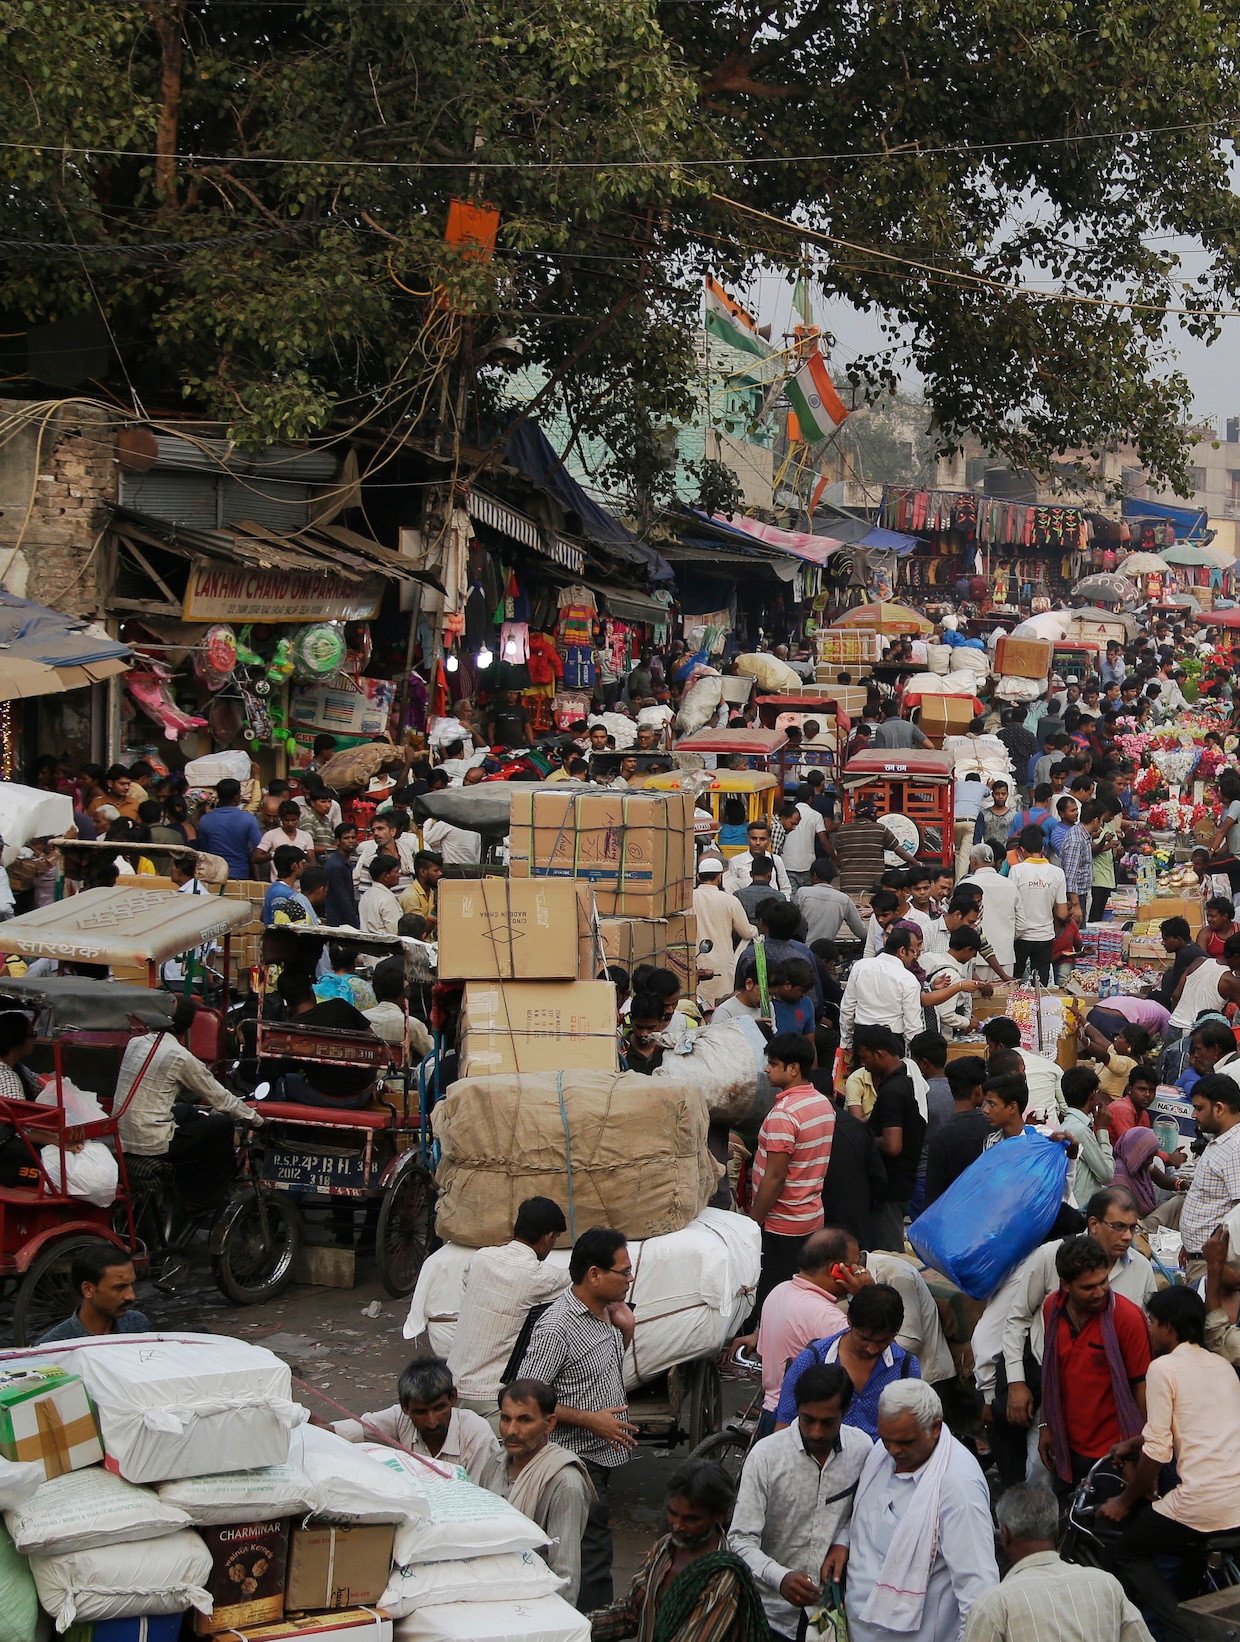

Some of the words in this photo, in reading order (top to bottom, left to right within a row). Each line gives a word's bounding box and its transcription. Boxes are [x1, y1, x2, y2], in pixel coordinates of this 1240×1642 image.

[194, 571, 244, 598] LAKHMI
[246, 572, 288, 600] CHAND
[358, 1049, 374, 1059] 318
[357, 1161, 379, 1173] 38
[278, 1167, 302, 1180] 2012
[309, 1174, 331, 1186] 318
[219, 1521, 281, 1542] CHARMINAR
